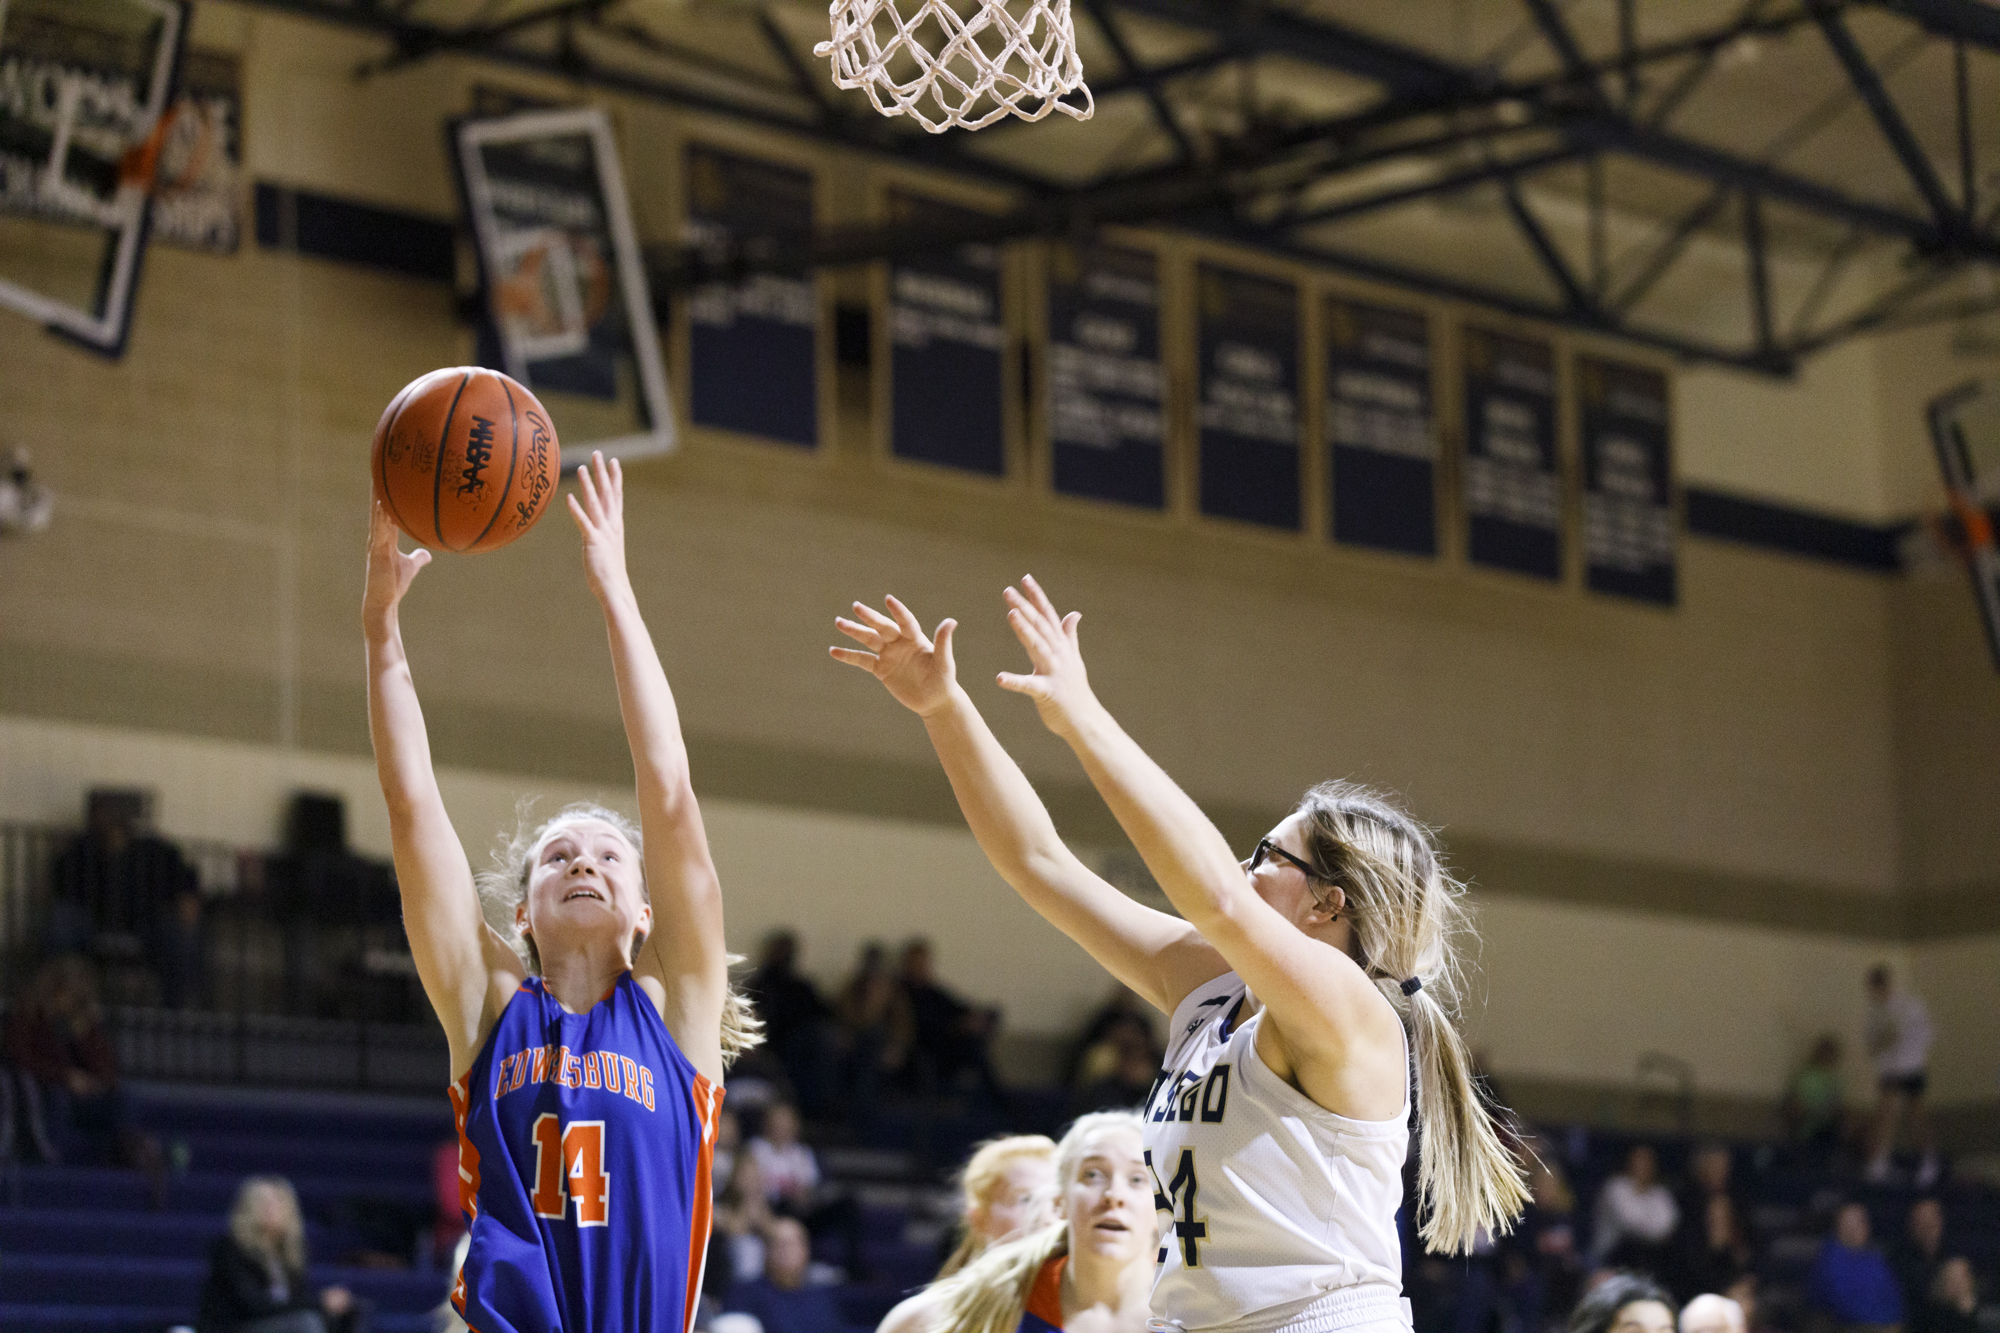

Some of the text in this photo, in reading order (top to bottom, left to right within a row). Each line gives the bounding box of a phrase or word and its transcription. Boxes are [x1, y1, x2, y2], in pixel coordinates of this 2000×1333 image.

[457, 415, 496, 498] MHSAA
[516, 410, 551, 531] Rawlings
[494, 1043, 656, 1113] EDWDSBURG
[1143, 1063, 1233, 1125] TSEGO
[530, 1112, 610, 1227] 14
